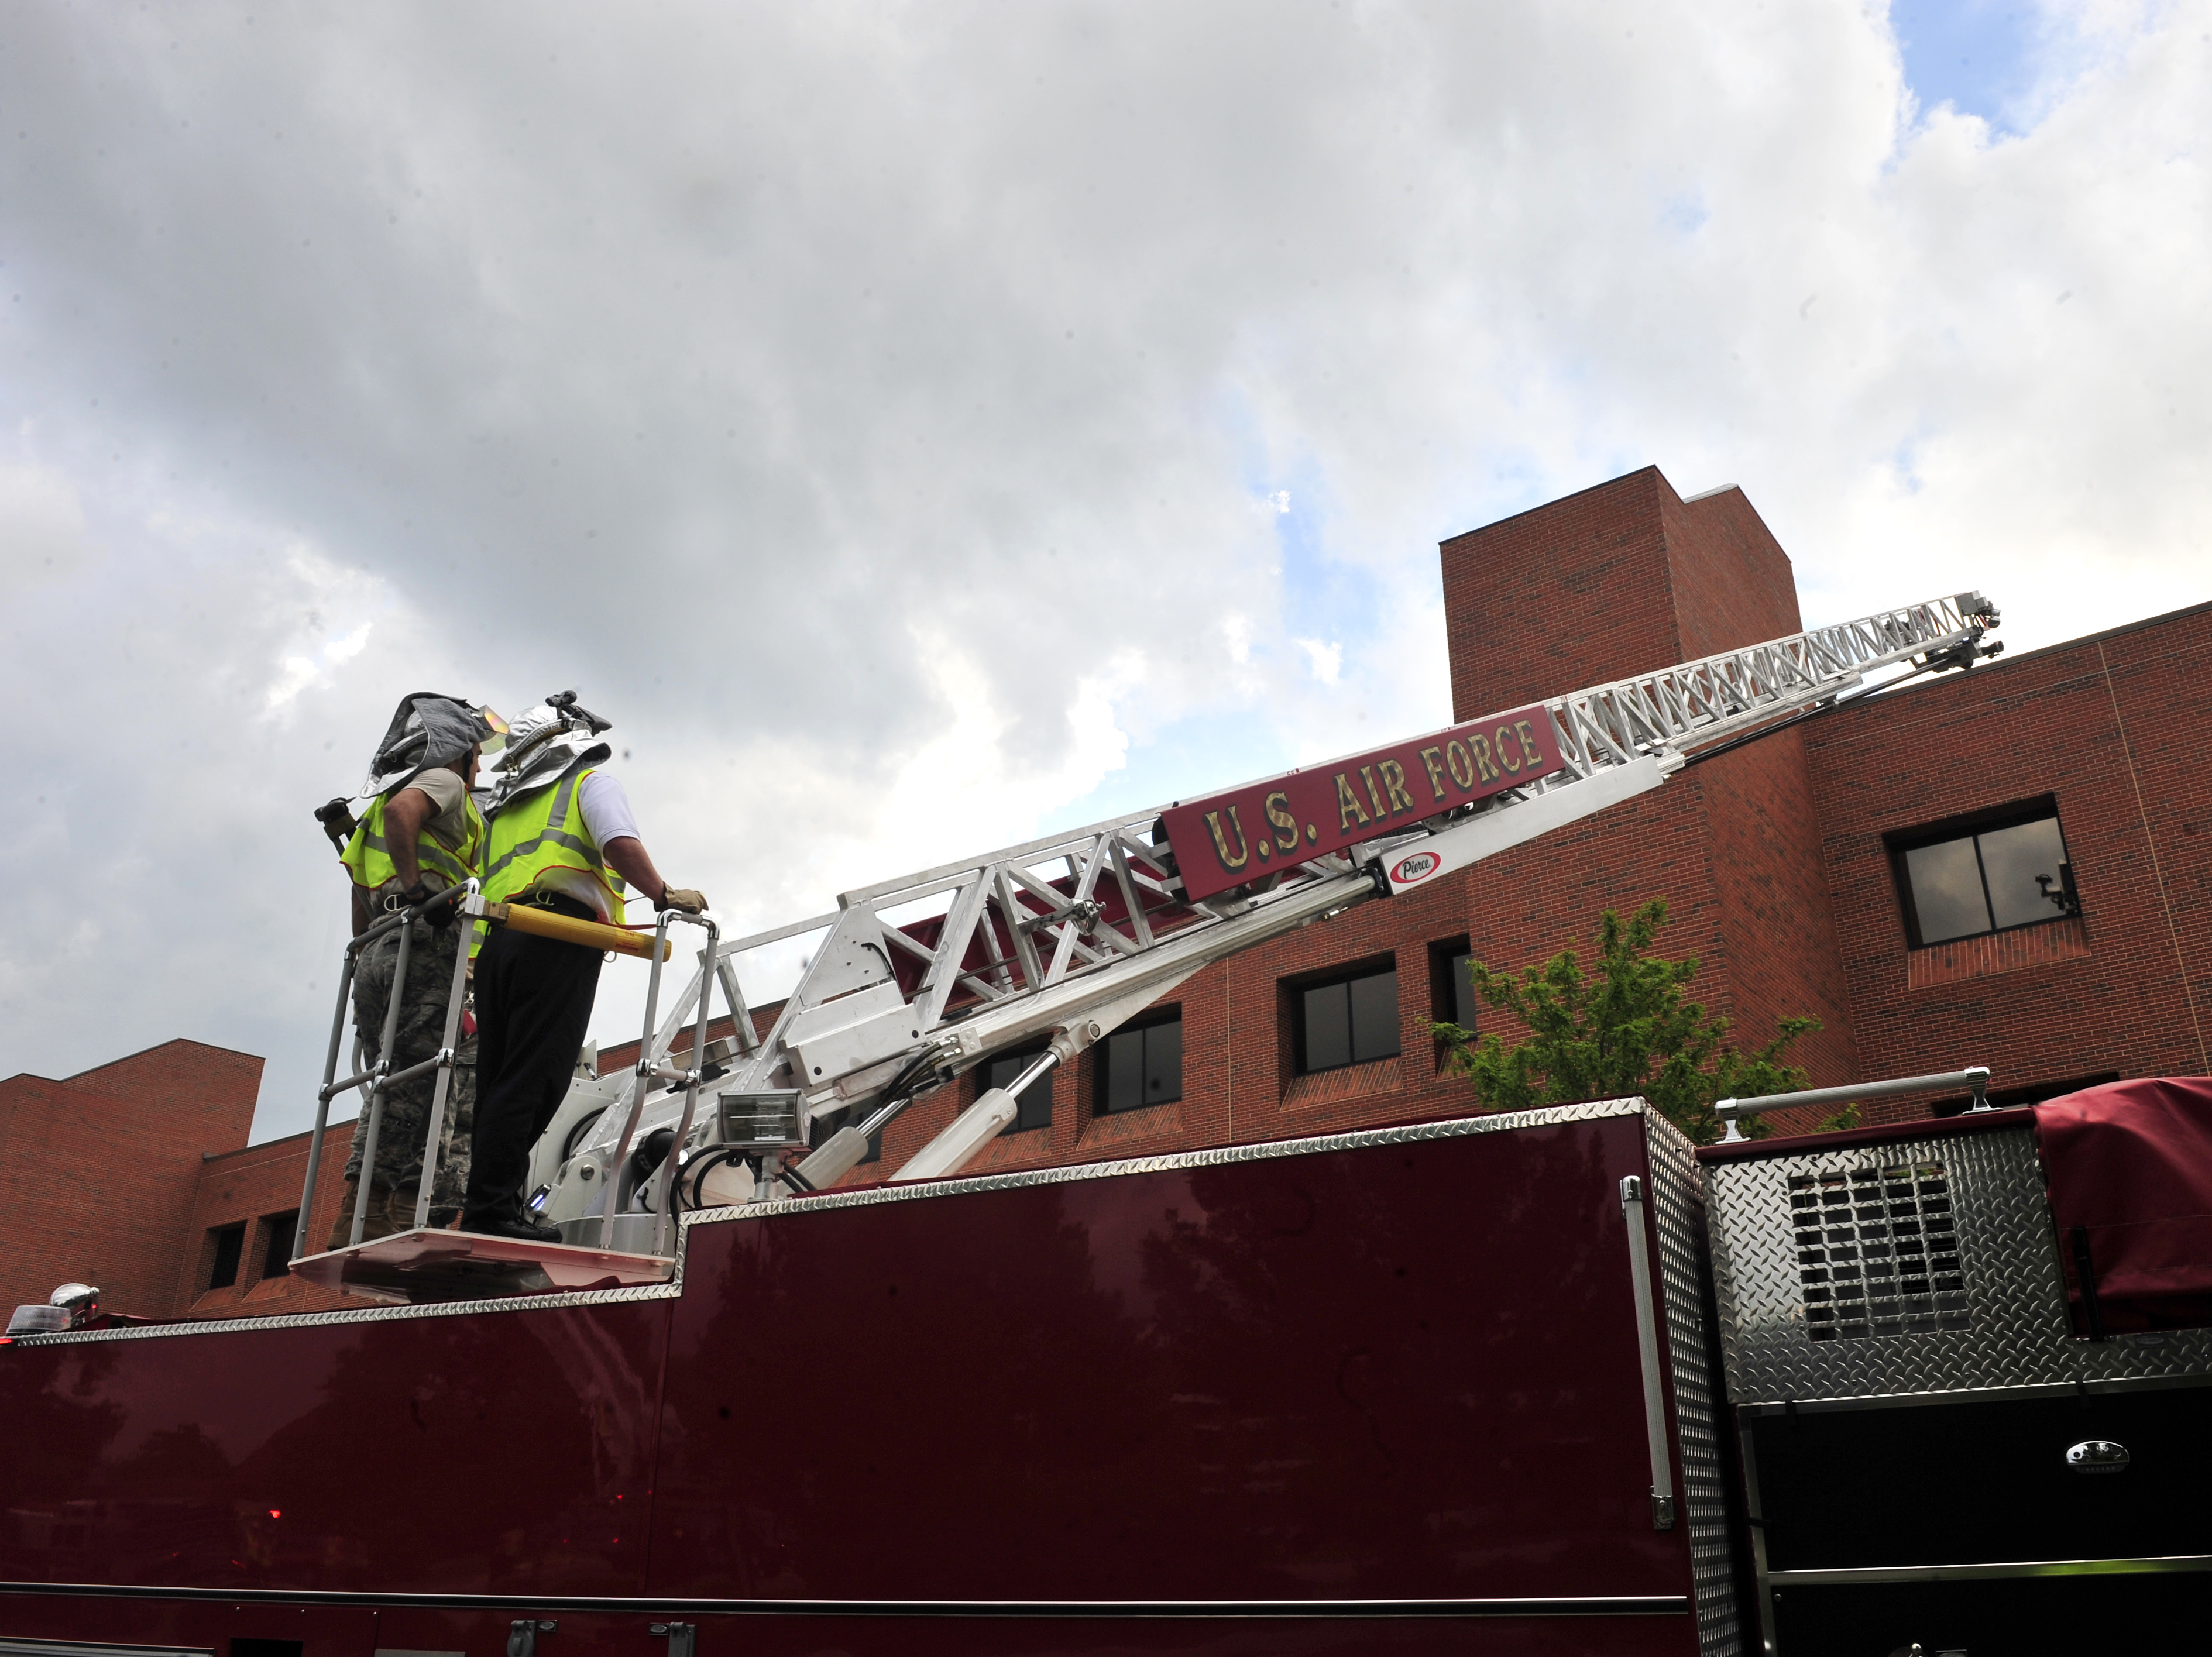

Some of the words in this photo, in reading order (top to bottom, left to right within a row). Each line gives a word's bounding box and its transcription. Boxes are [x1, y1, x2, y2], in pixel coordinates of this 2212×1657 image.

[1203, 790, 1317, 871] U.S.
[1334, 759, 1414, 833] AIR
[1418, 719, 1543, 802] FORCE
[1402, 858, 1430, 879] Pierce
